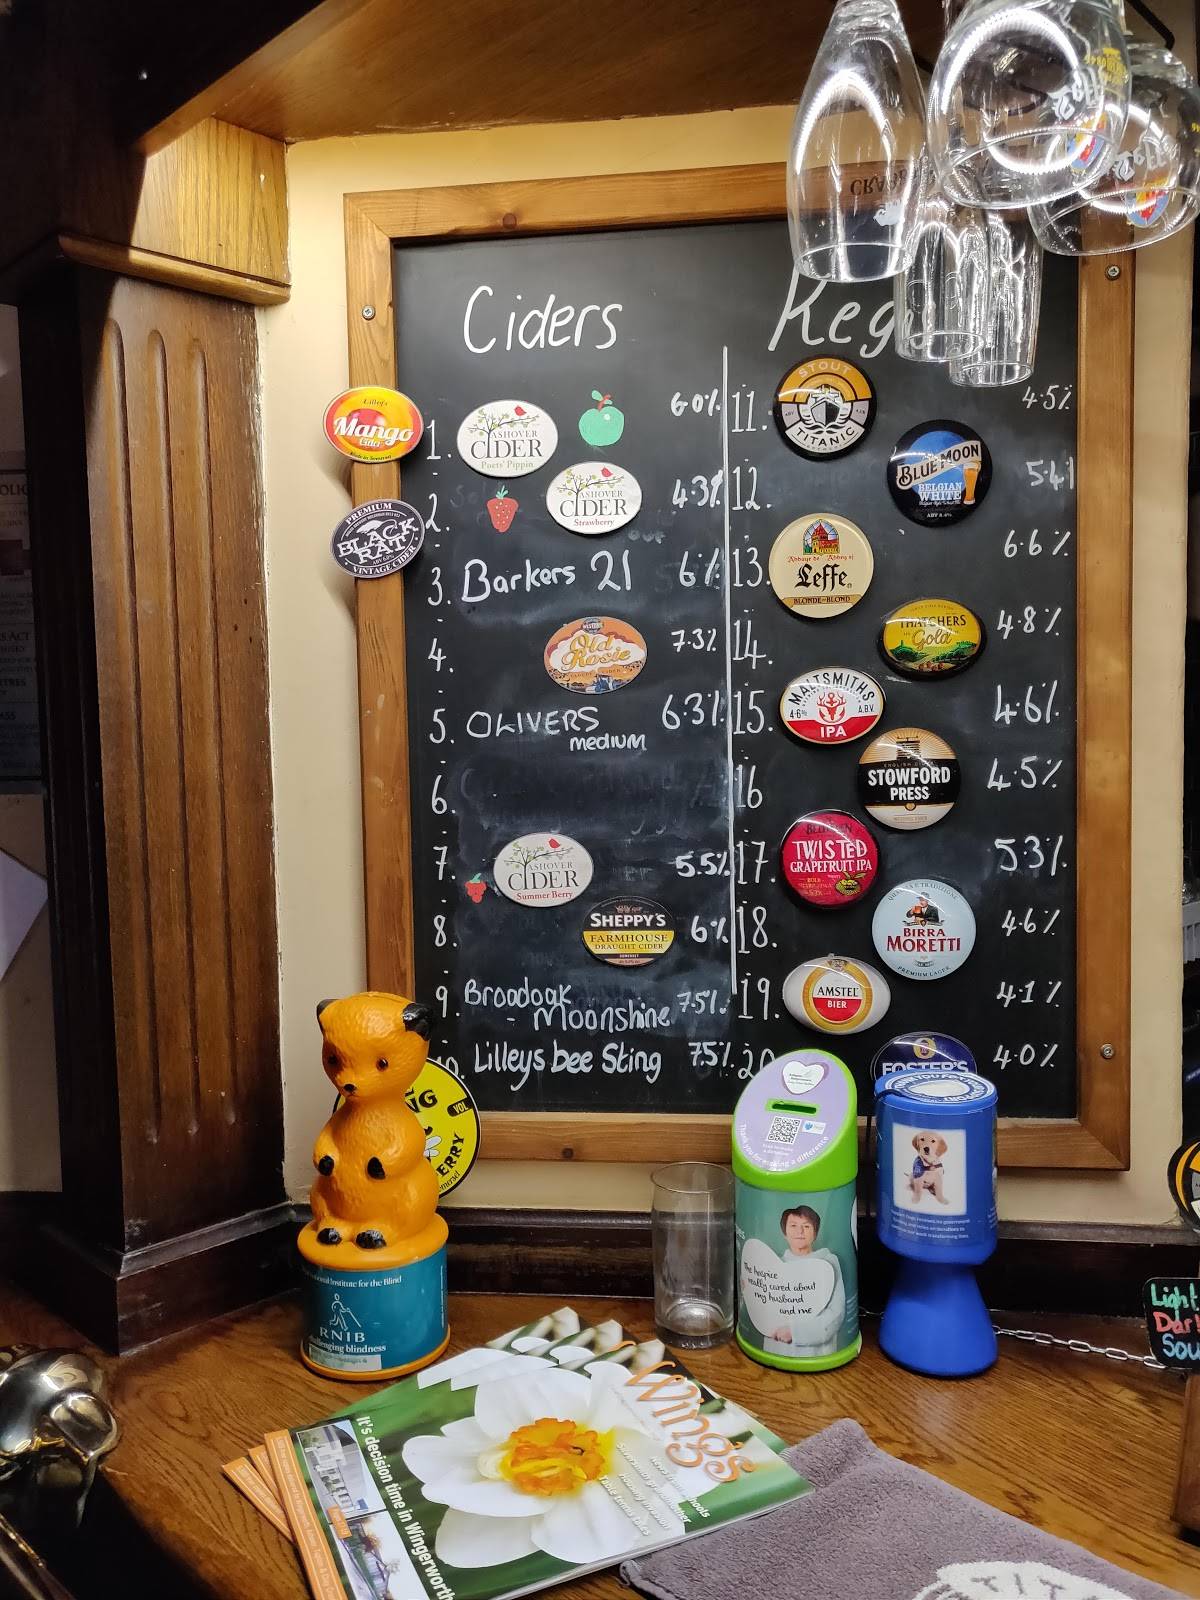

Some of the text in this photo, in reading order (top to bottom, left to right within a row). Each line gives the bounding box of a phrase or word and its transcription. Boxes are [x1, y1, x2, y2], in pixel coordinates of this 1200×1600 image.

[463, 285, 623, 354] Ciders
[798, 361, 852, 378] STOUT
[334, 416, 414, 446] Mango
[490, 430, 538, 438] ASHOVER
[796, 427, 855, 447] TITANIC
[471, 438, 543, 459] CIDER
[506, 460, 534, 471] Pippin
[899, 460, 938, 487] BLUE
[579, 490, 623, 498] ASHOVER
[918, 482, 963, 492] BELGIAN
[919, 491, 962, 501] WHITE
[345, 502, 392, 525] PREMIUM
[560, 499, 628, 517] CIDER
[574, 518, 614, 527] Strawberry
[337, 517, 419, 557] BLACK
[354, 535, 407, 564] RAT
[353, 545, 417, 575] VINTAGE CIDER
[461, 550, 631, 603] Barkers 21
[794, 563, 848, 592] Leffe
[793, 595, 851, 605] BLONDE BLOND
[570, 634, 615, 653] Old
[912, 628, 952, 651] Gold
[561, 647, 631, 671] Rosie
[788, 672, 875, 706] MALTSMITHS
[466, 706, 600, 738] OLIVERS
[820, 726, 847, 738] IPA
[867, 766, 951, 787] STOWFORD
[890, 786, 930, 801] PRESS
[792, 839, 867, 860] TWISTED
[527, 861, 573, 871] ASHOVER
[790, 859, 872, 873] GRAPEFRUIT IPA
[508, 870, 580, 891] CIDER
[516, 891, 573, 900] Summer Berry
[590, 913, 666, 927] SHEPPY'S
[590, 933, 669, 943] FARMHOUSE
[903, 928, 946, 937] BIRRA
[887, 935, 961, 952] MORETTI
[897, 966, 928, 977] PREMIUM
[817, 986, 859, 997] AMSTEL
[827, 1000, 848, 1009] BIER
[533, 998, 671, 1033] Moonshine
[474, 1041, 546, 1091] Lilleys
[601, 1042, 662, 1084] Sting
[453, 1101, 469, 1114] VOL
[436, 1131, 464, 1177] ERRY
[753, 1265, 778, 1280] hospice
[358, 1279, 369, 1288] for
[370, 1279, 382, 1287] the
[384, 1275, 402, 1286] Blind
[748, 1277, 816, 1292] really cared about
[754, 1292, 804, 1304] my husband
[779, 1306, 796, 1315] and
[320, 1327, 365, 1343] RNIB
[346, 1344, 386, 1353] blindness
[1162, 1334, 1200, 1360] Sou
[624, 1361, 756, 1483] Wings
[355, 1415, 373, 1436] It's
[364, 1436, 394, 1485] decision
[384, 1483, 406, 1508] time
[398, 1509, 412, 1523] in
